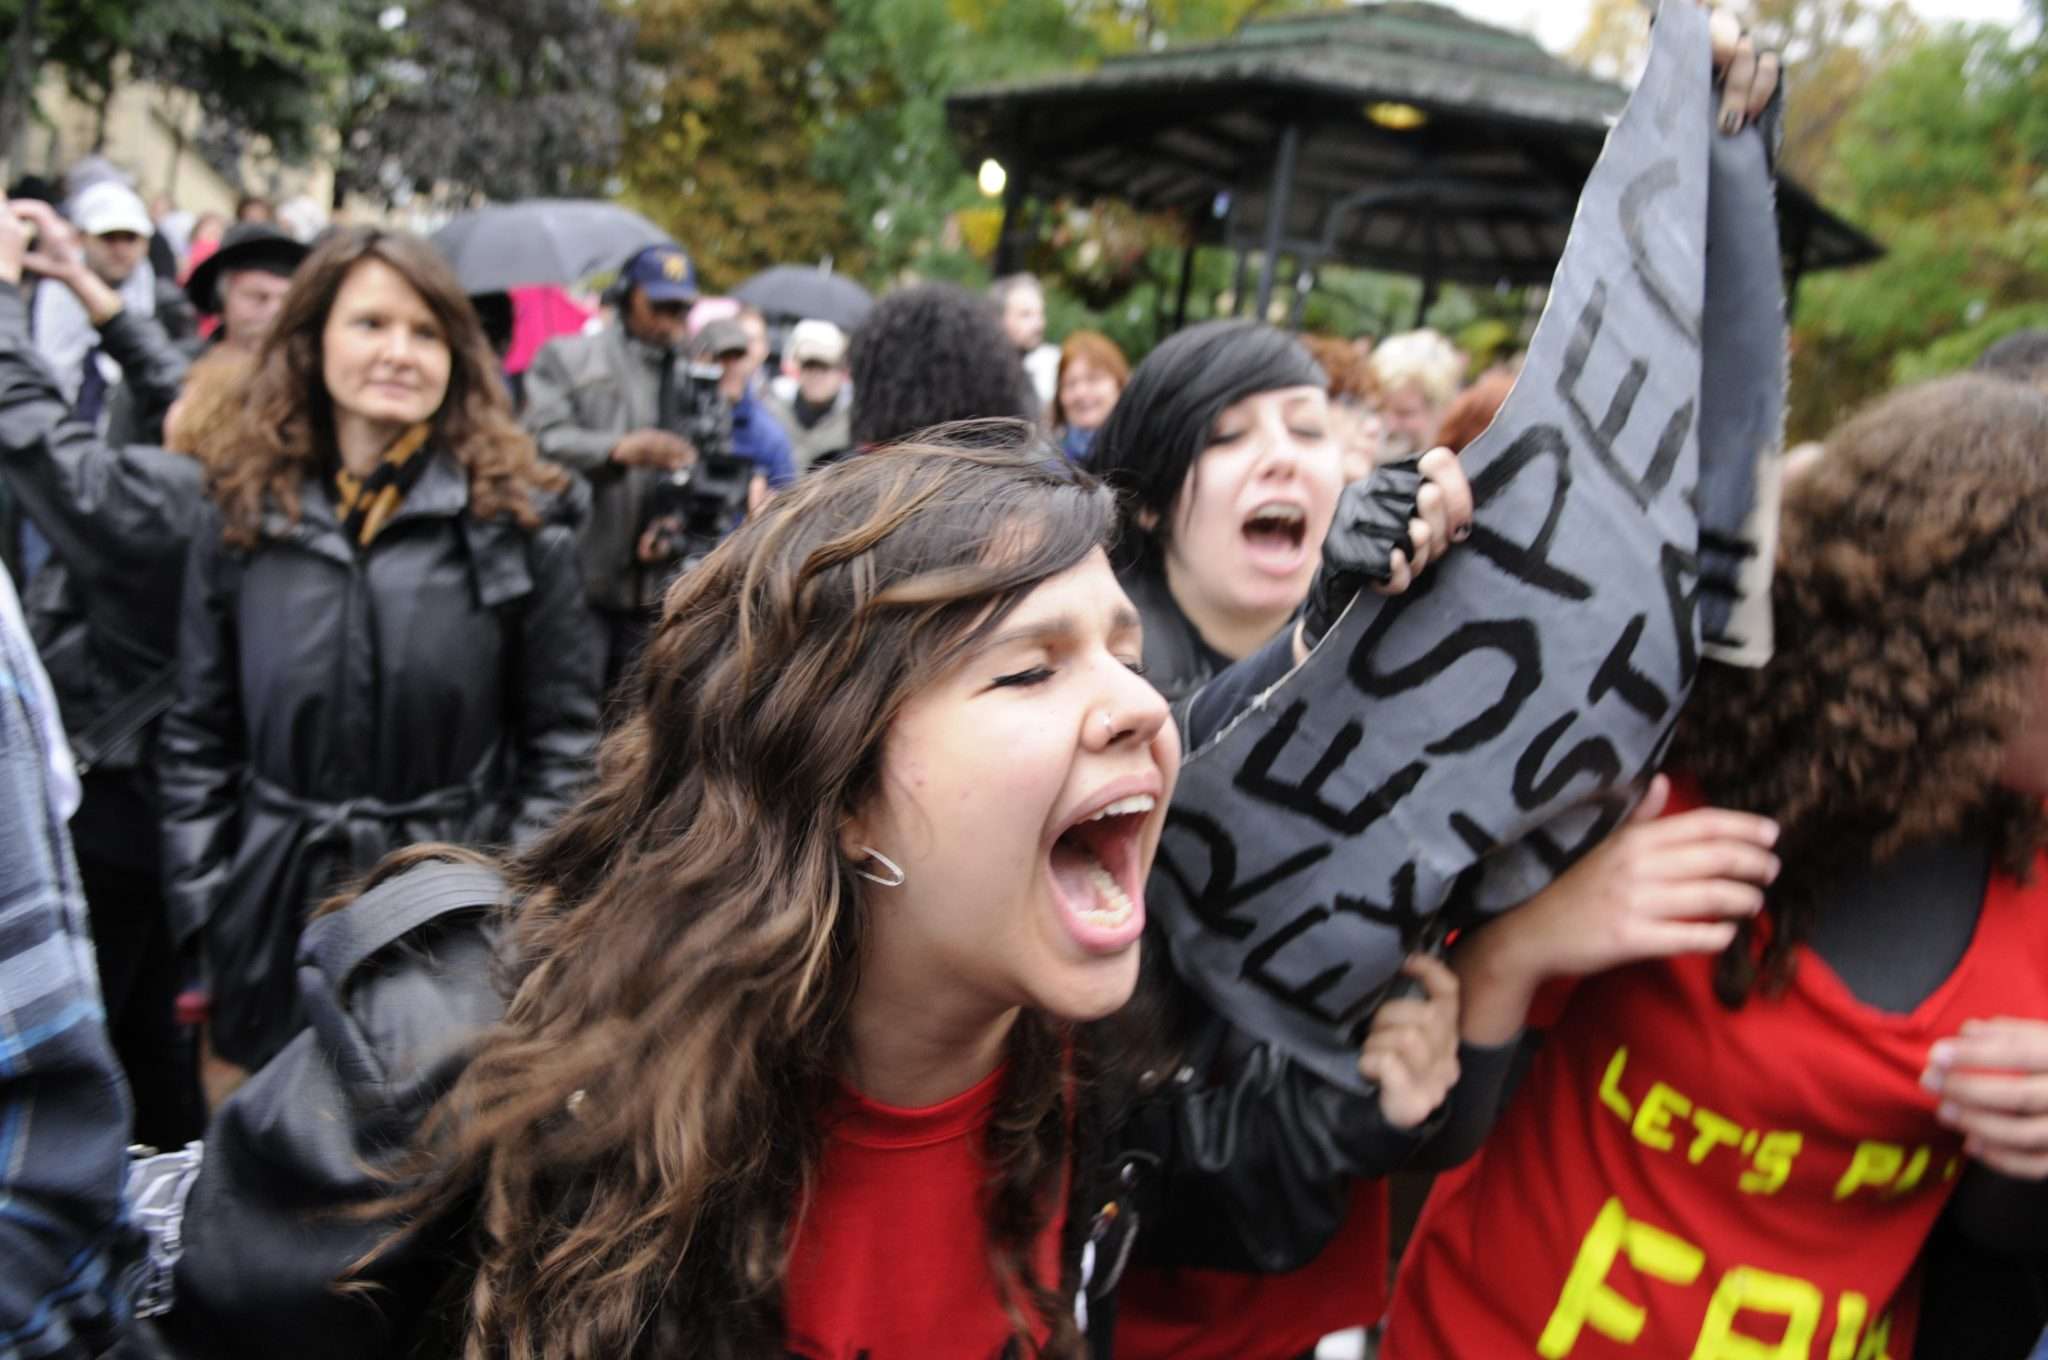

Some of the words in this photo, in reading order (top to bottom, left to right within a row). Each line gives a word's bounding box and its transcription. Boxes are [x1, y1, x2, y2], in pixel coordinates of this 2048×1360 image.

[1160, 100, 1700, 940] RESPEC
[1240, 542, 1701, 1028] EXISTA
[1537, 1197, 1894, 1360] FAI
[1599, 1047, 1804, 1194] LET'S
